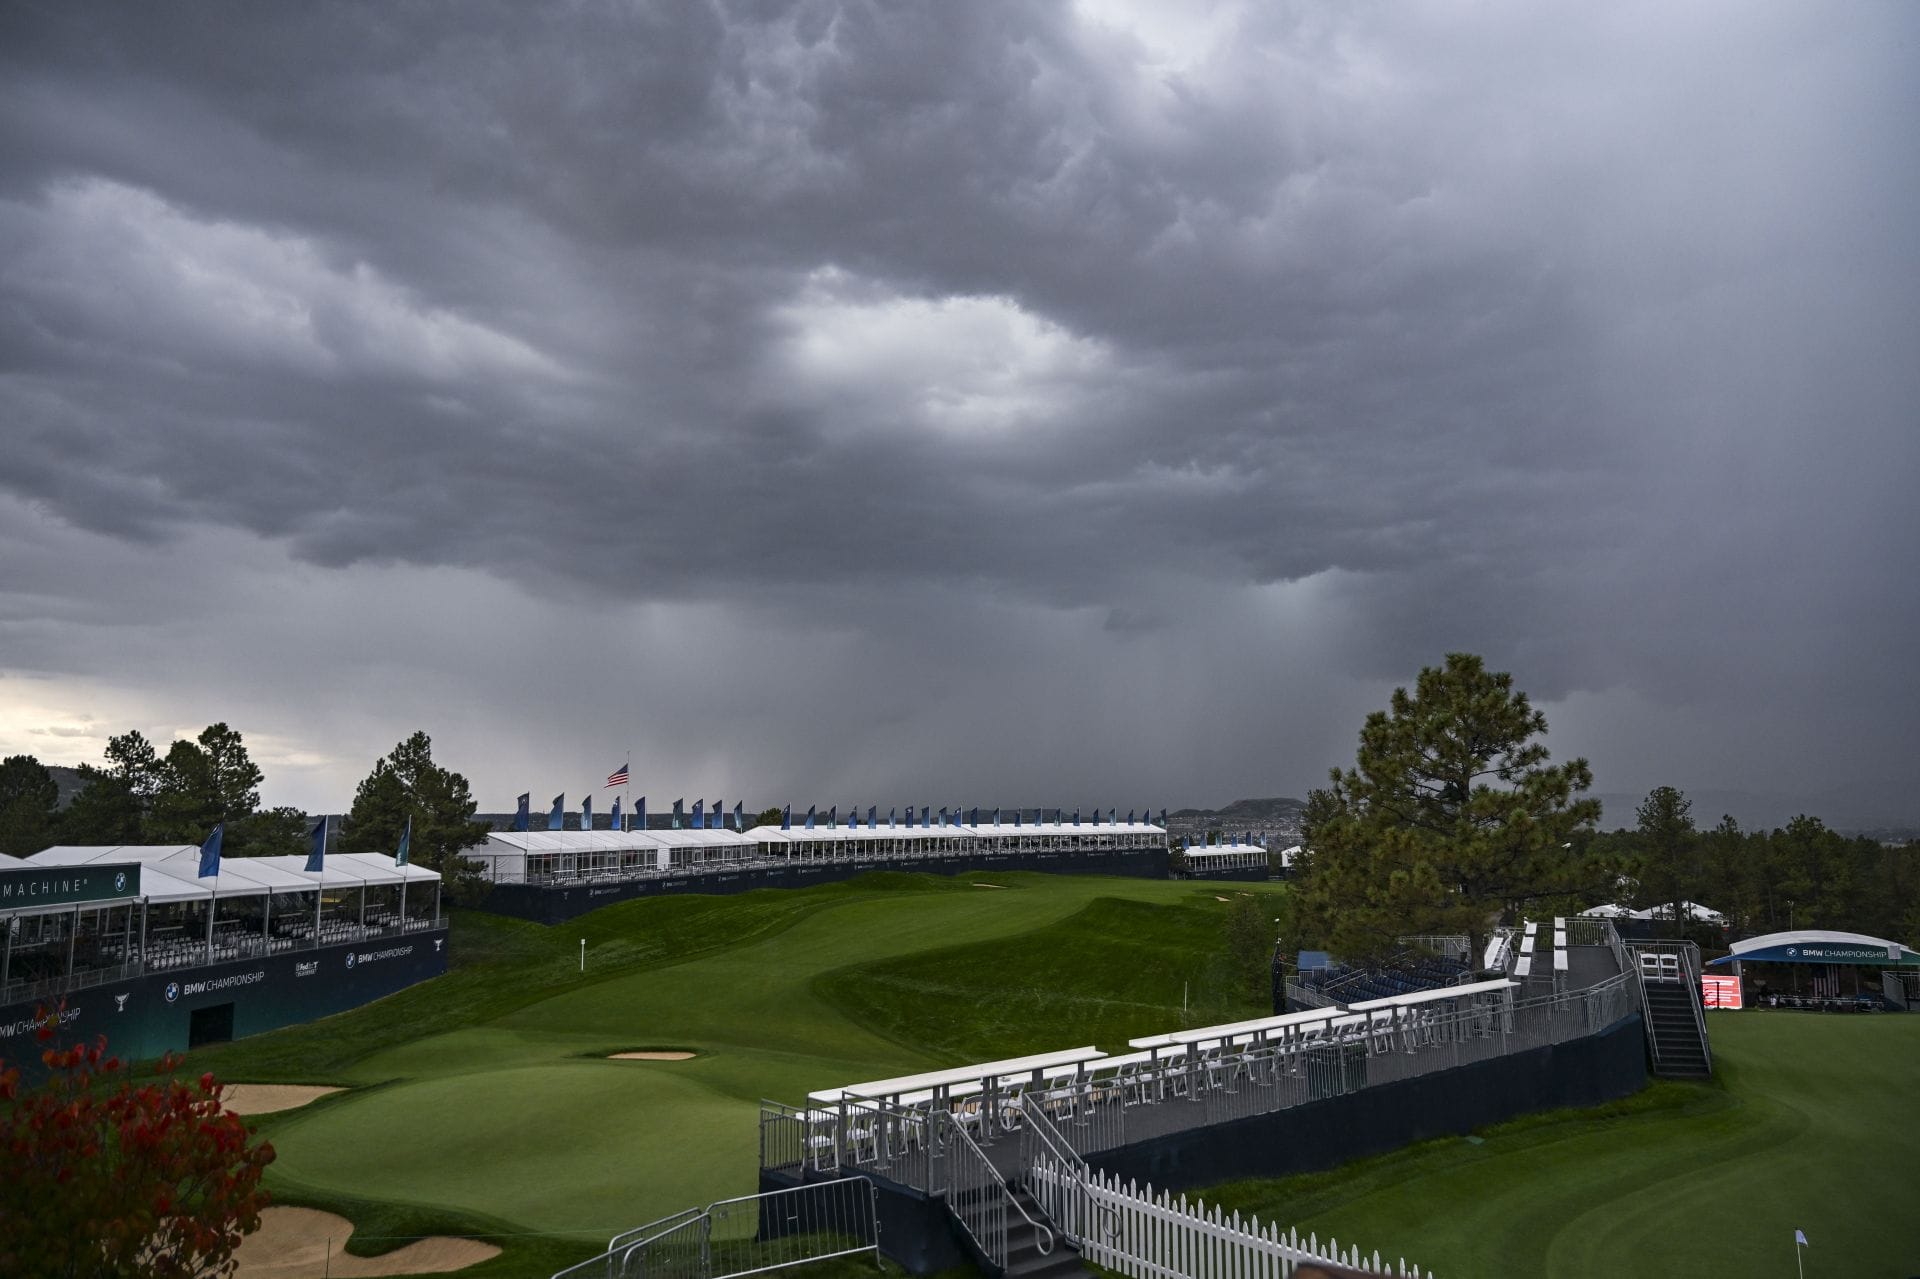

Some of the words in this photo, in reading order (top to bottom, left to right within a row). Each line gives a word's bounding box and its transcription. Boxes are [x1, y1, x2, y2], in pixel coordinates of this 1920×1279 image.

[359, 952, 373, 963] BMW
[1803, 949, 1823, 957] BMW
[1825, 950, 1887, 958] CHAMPIONSHIP
[184, 982, 206, 995] BMW
[206, 971, 265, 991] CHAMPIONSHIP
[0, 1023, 16, 1038] MW
